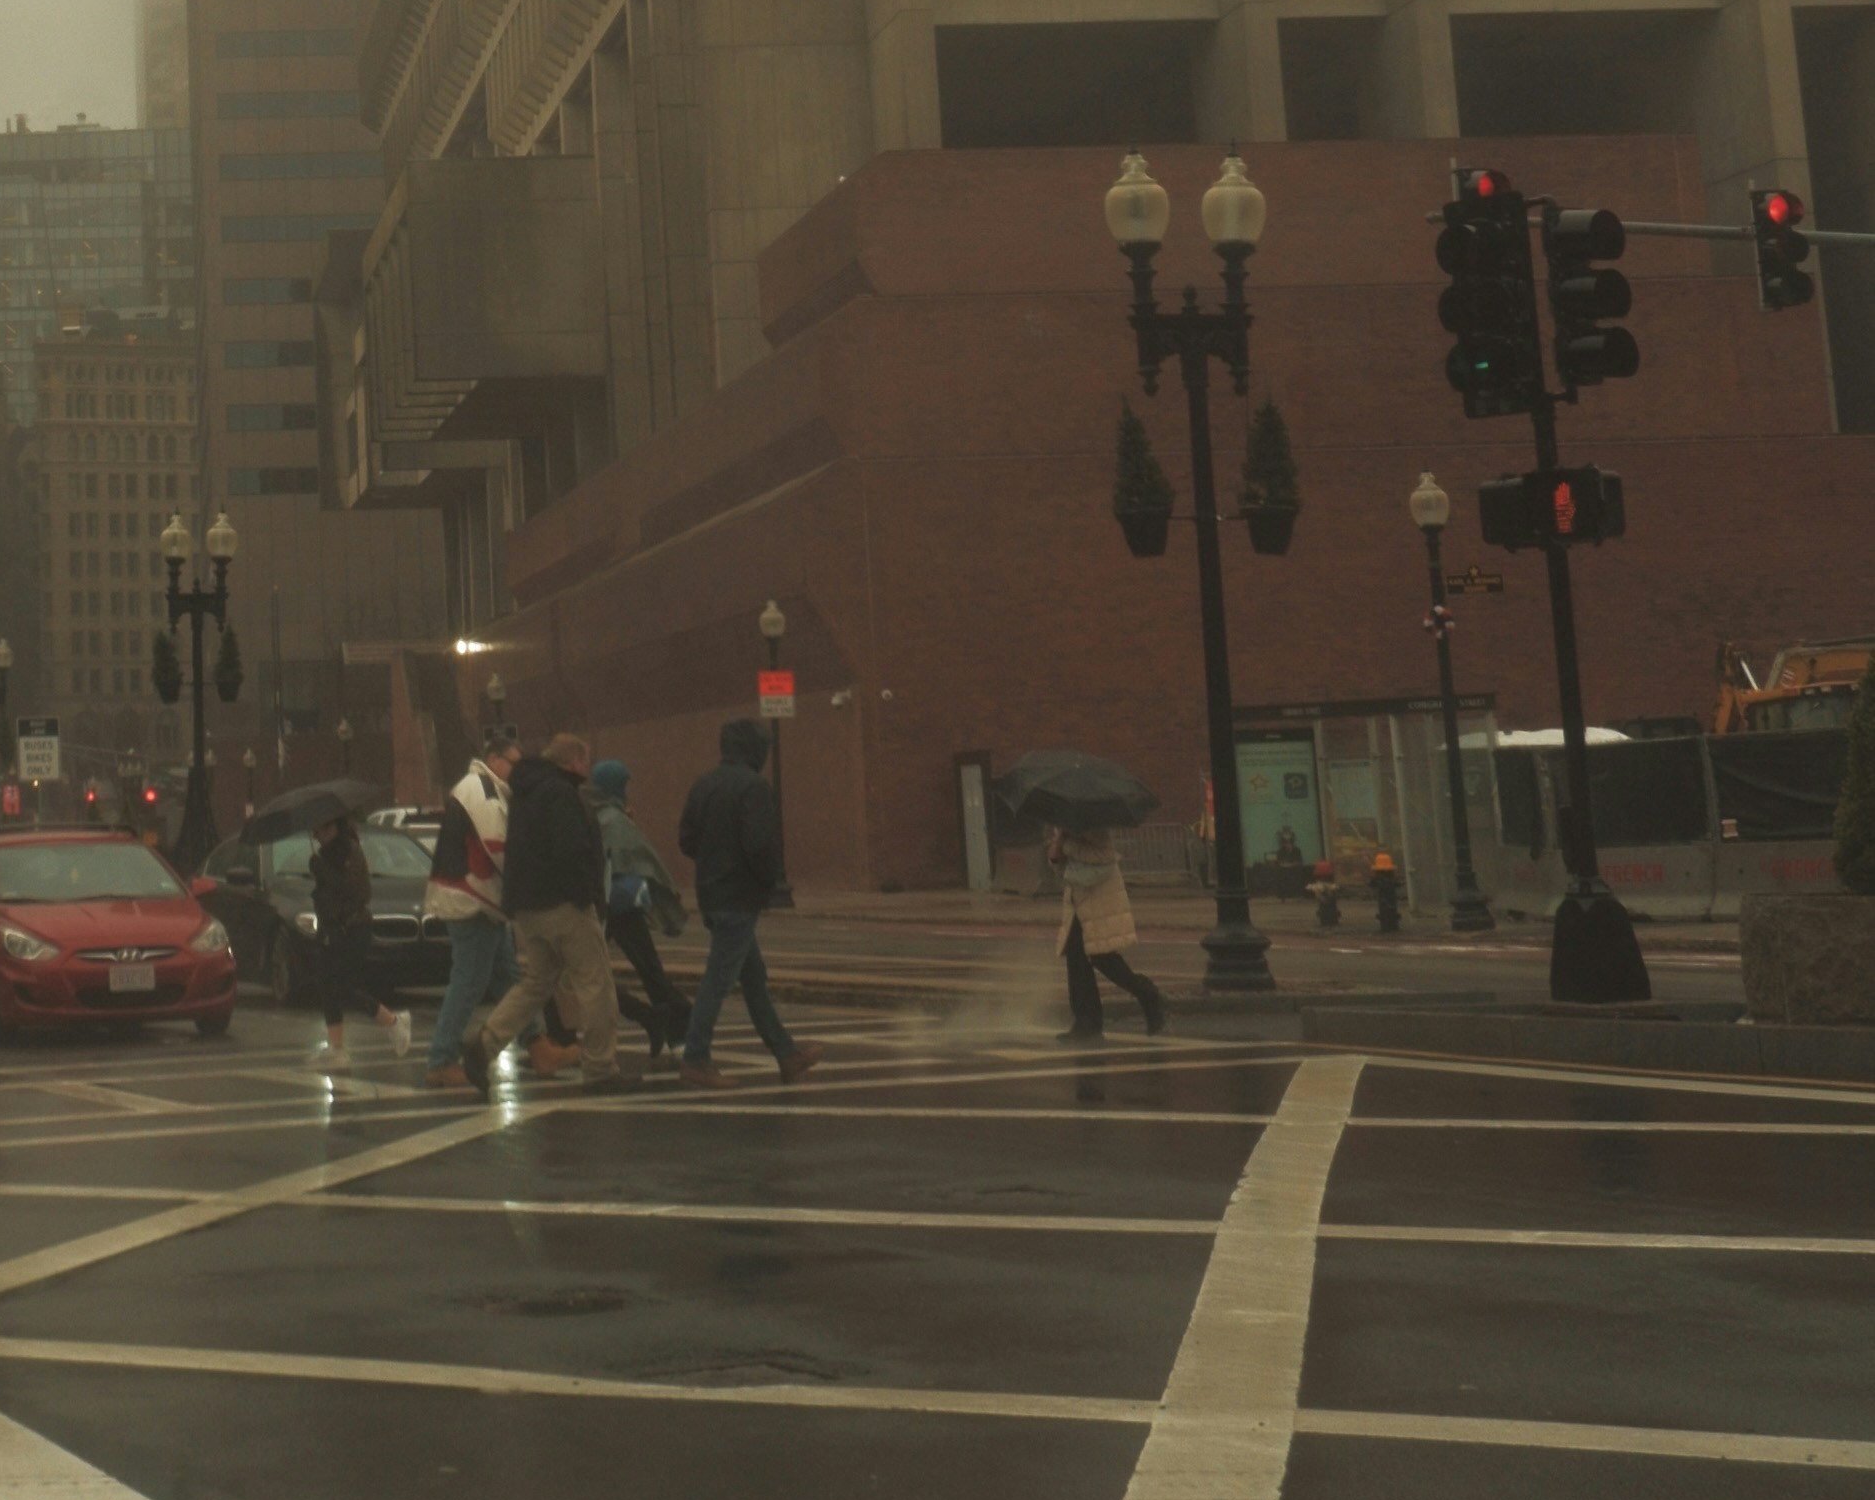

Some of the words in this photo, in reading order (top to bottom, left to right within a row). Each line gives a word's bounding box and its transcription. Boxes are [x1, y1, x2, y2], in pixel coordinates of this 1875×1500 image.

[24, 740, 54, 751] BUSES
[26, 753, 52, 763] BIKES
[27, 765, 51, 775] ONLY
[1604, 863, 1662, 882] FRENCH
